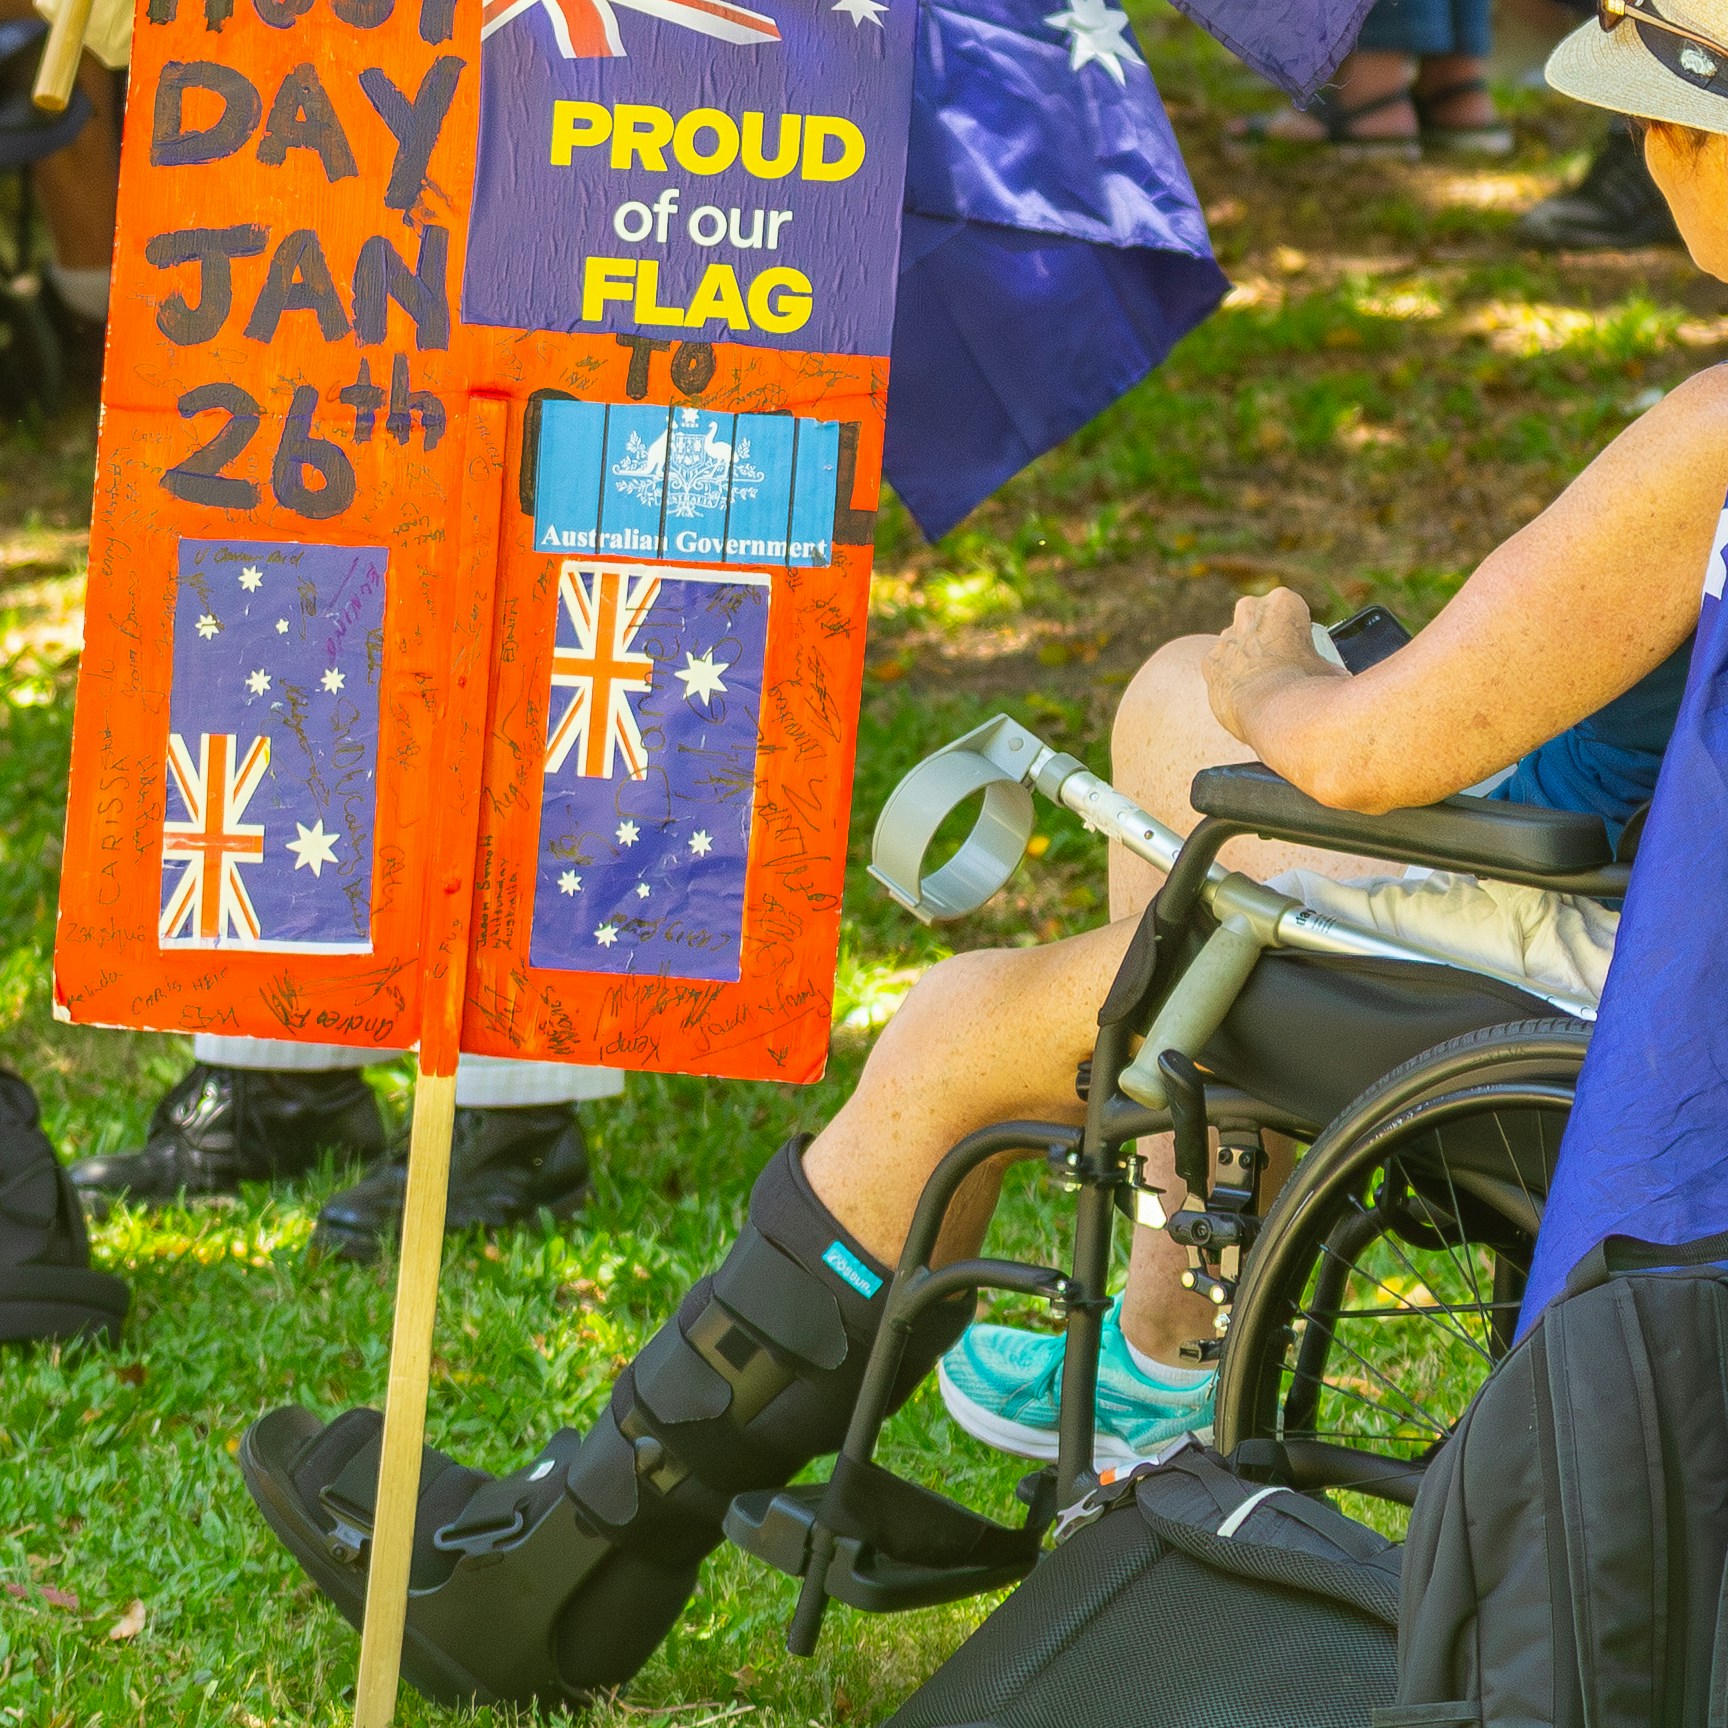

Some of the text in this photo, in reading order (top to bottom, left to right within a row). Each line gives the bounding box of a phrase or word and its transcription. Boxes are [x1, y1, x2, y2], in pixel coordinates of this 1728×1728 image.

[149, 56, 466, 210] DAY
[550, 100, 866, 182] PROUD
[613, 188, 793, 250] of our
[145, 225, 450, 351] JAN
[582, 256, 813, 334] FLAG
[616, 336, 716, 401] TO
[159, 352, 447, 519] 26th
[541, 524, 828, 561] Australian Government
